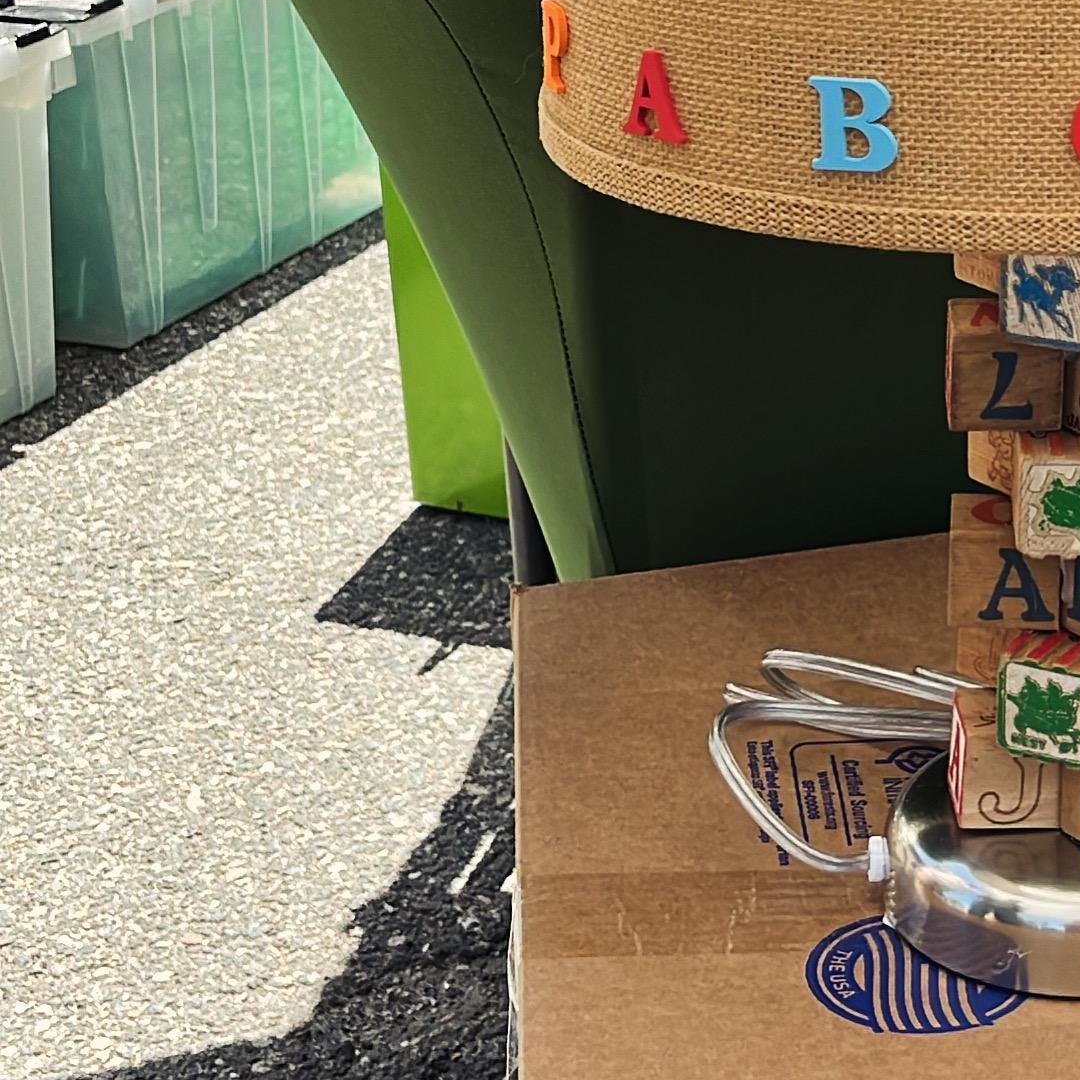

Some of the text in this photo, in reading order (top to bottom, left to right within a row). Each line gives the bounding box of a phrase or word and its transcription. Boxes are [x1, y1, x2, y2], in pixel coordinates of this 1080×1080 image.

[623, 50, 687, 143] A
[808, 75, 898, 173] B
[977, 548, 1055, 622] A
[842, 759, 872, 839] Certified Sourcing
[828, 950, 856, 999] THE USA
